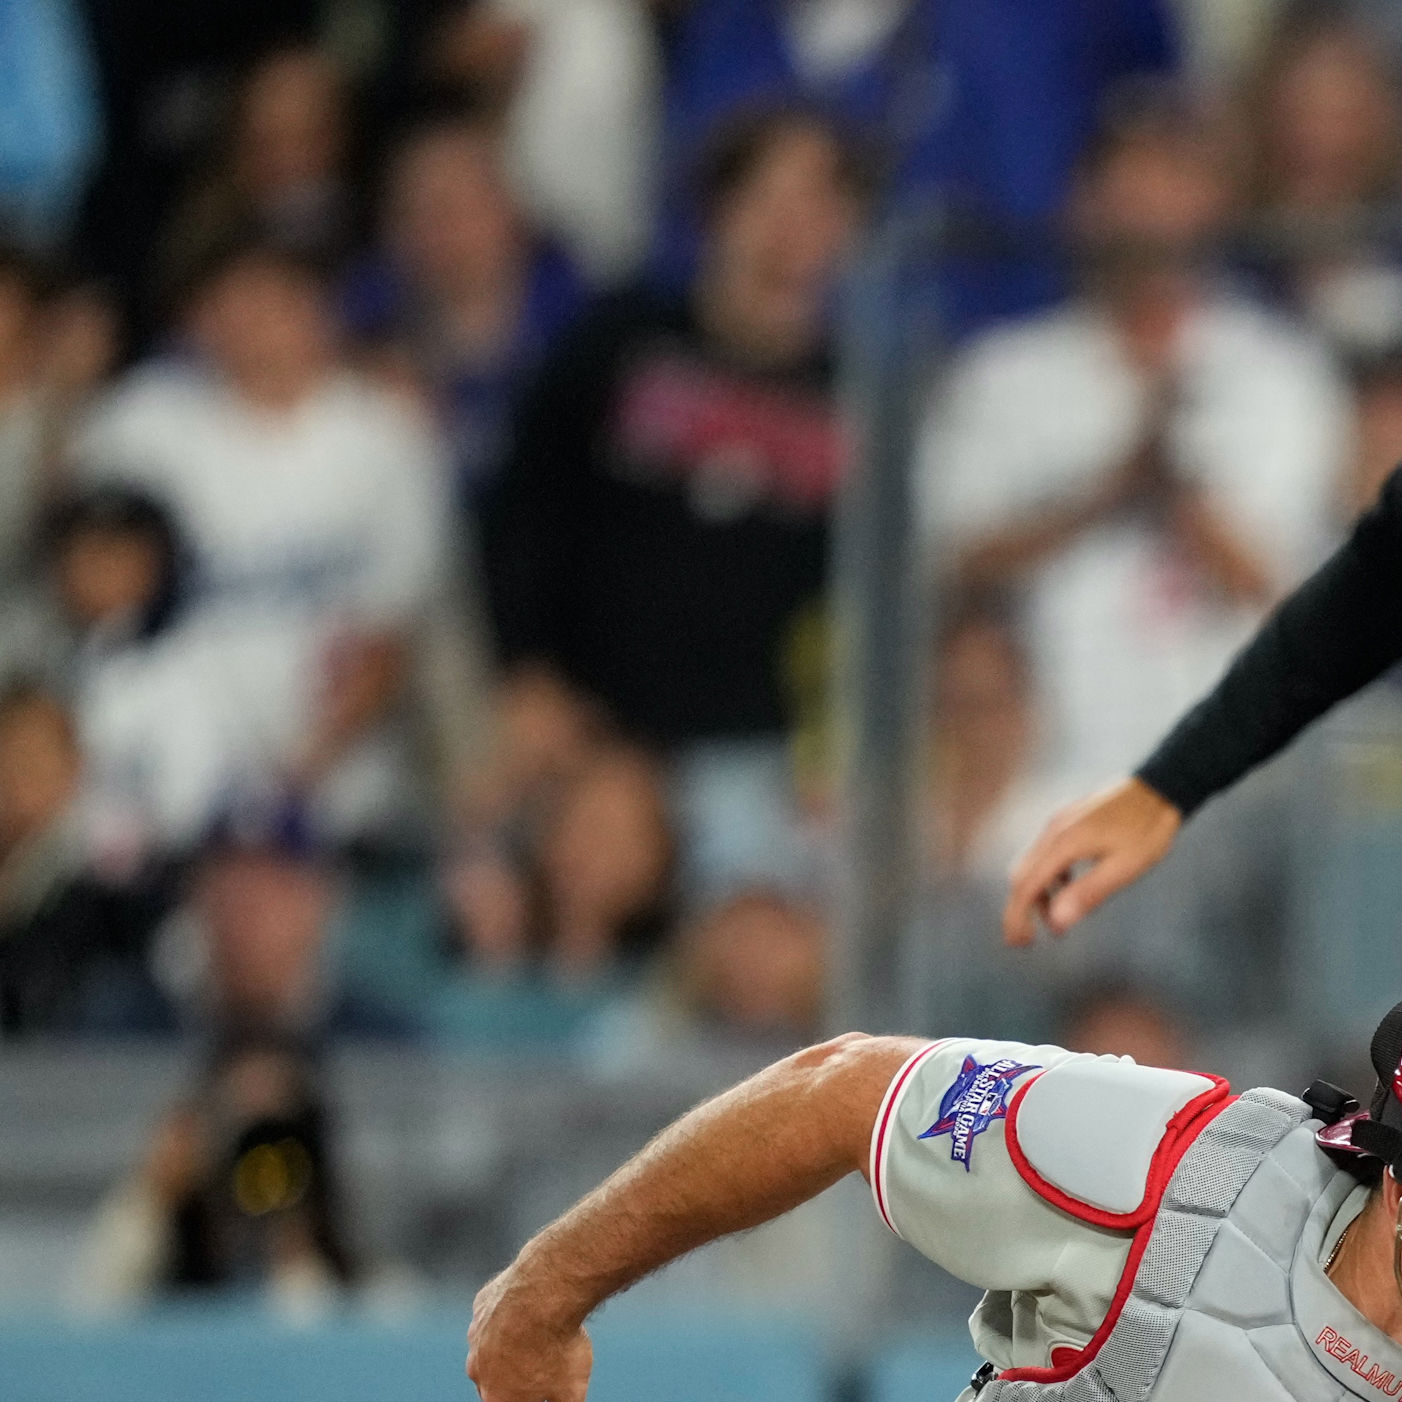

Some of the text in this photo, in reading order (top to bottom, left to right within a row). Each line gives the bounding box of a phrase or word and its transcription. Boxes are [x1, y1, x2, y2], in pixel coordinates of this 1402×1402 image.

[988, 1060, 1016, 1078] ALL
[962, 1079, 996, 1114] STAR
[953, 1113, 975, 1160] GAME
